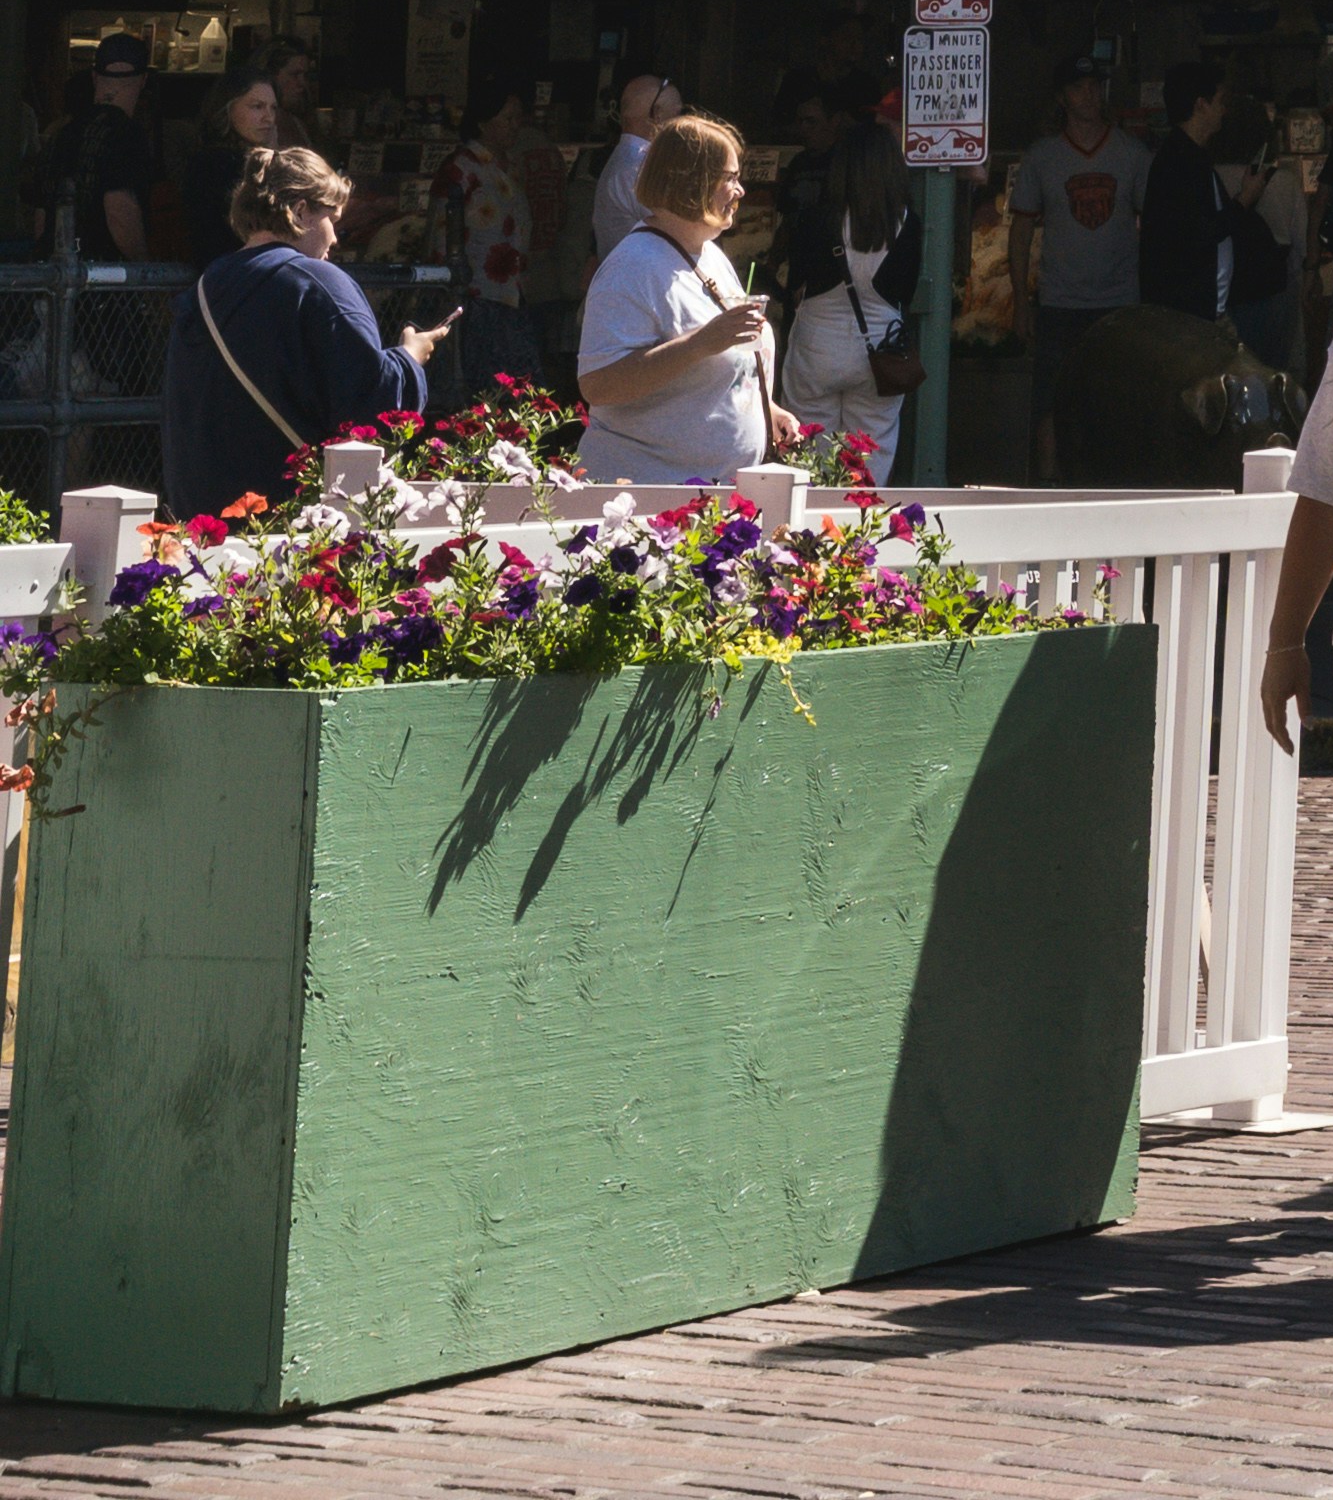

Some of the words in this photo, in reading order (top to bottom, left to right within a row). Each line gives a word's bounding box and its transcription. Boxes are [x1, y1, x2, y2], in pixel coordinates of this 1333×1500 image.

[939, 35, 981, 46] MINUTE
[912, 55, 981, 71] PASSENGER
[911, 74, 942, 90] LOAD
[950, 73, 981, 89] ONLY
